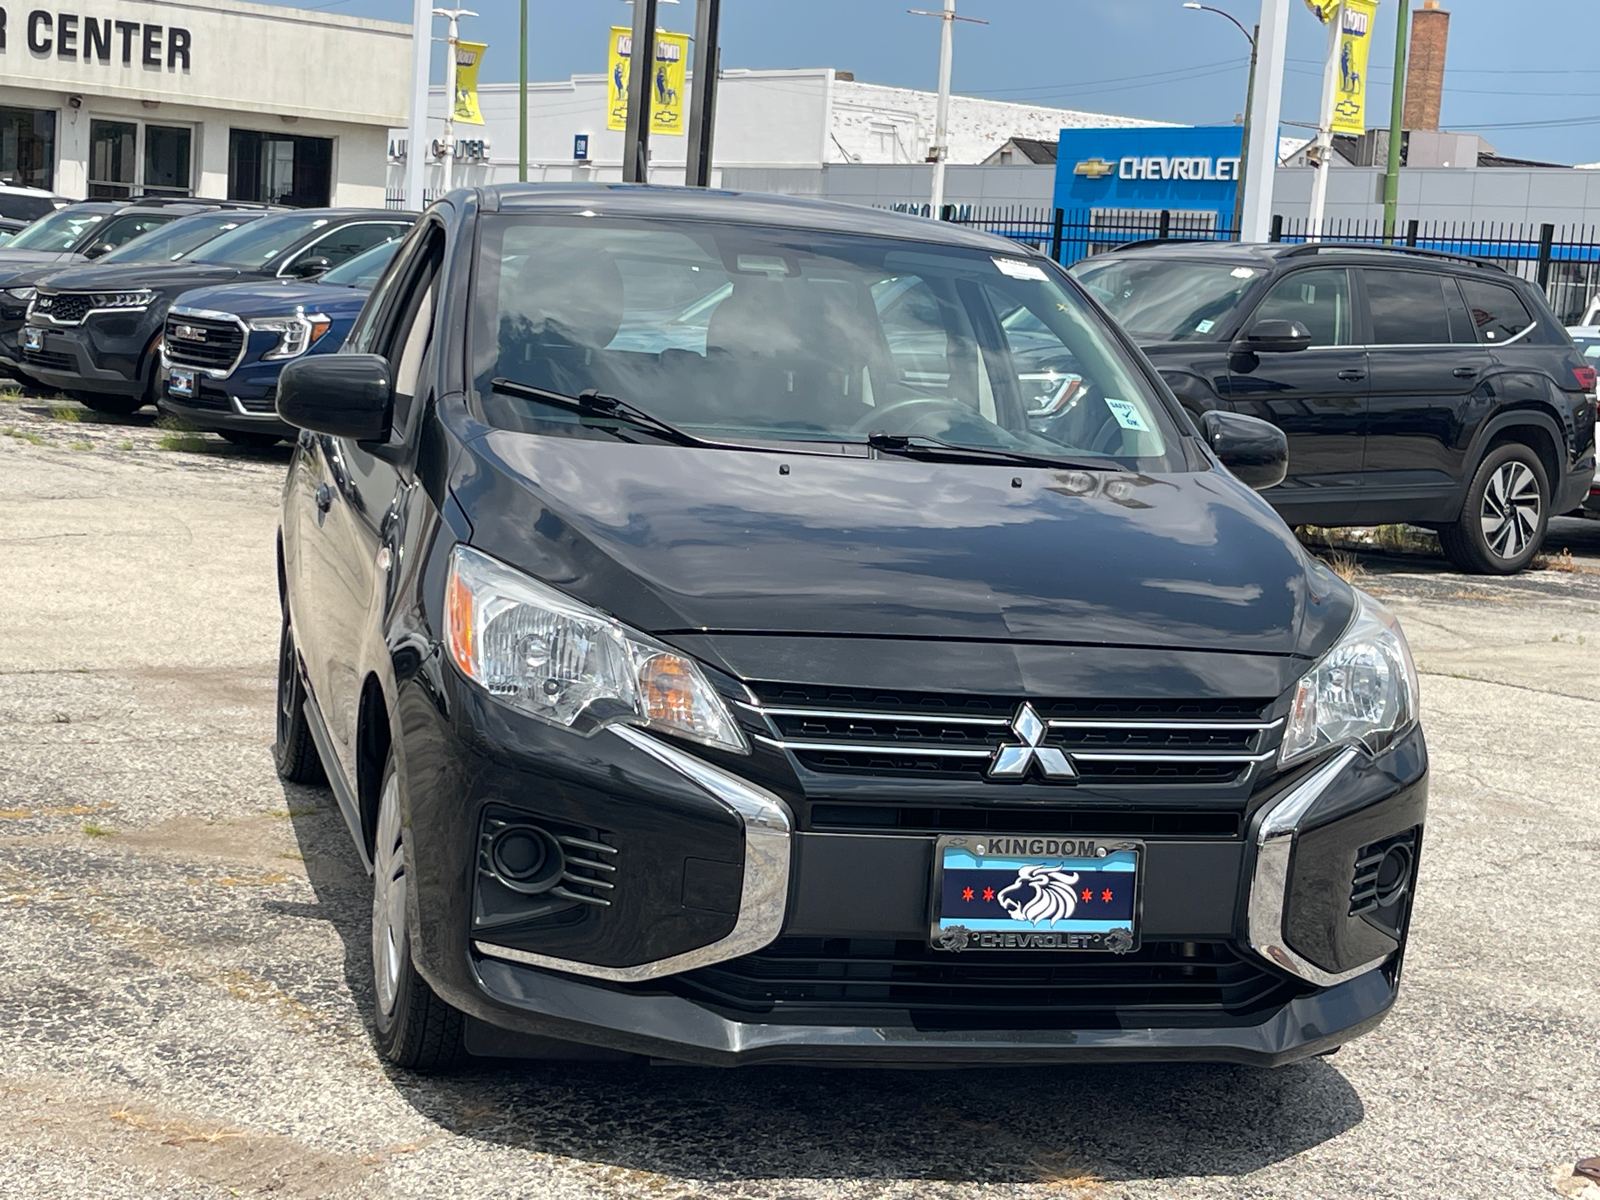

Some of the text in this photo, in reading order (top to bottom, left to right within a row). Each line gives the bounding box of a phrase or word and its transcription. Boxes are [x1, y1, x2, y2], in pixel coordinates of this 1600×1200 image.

[27, 9, 192, 69] CENTER
[1118, 156, 1242, 181] CHEVROLET
[1109, 401, 1135, 411] SAFETY
[1126, 418, 1140, 427] OK
[988, 838, 1096, 858] KINGDOM
[980, 933, 1093, 949] CHEVROLET
